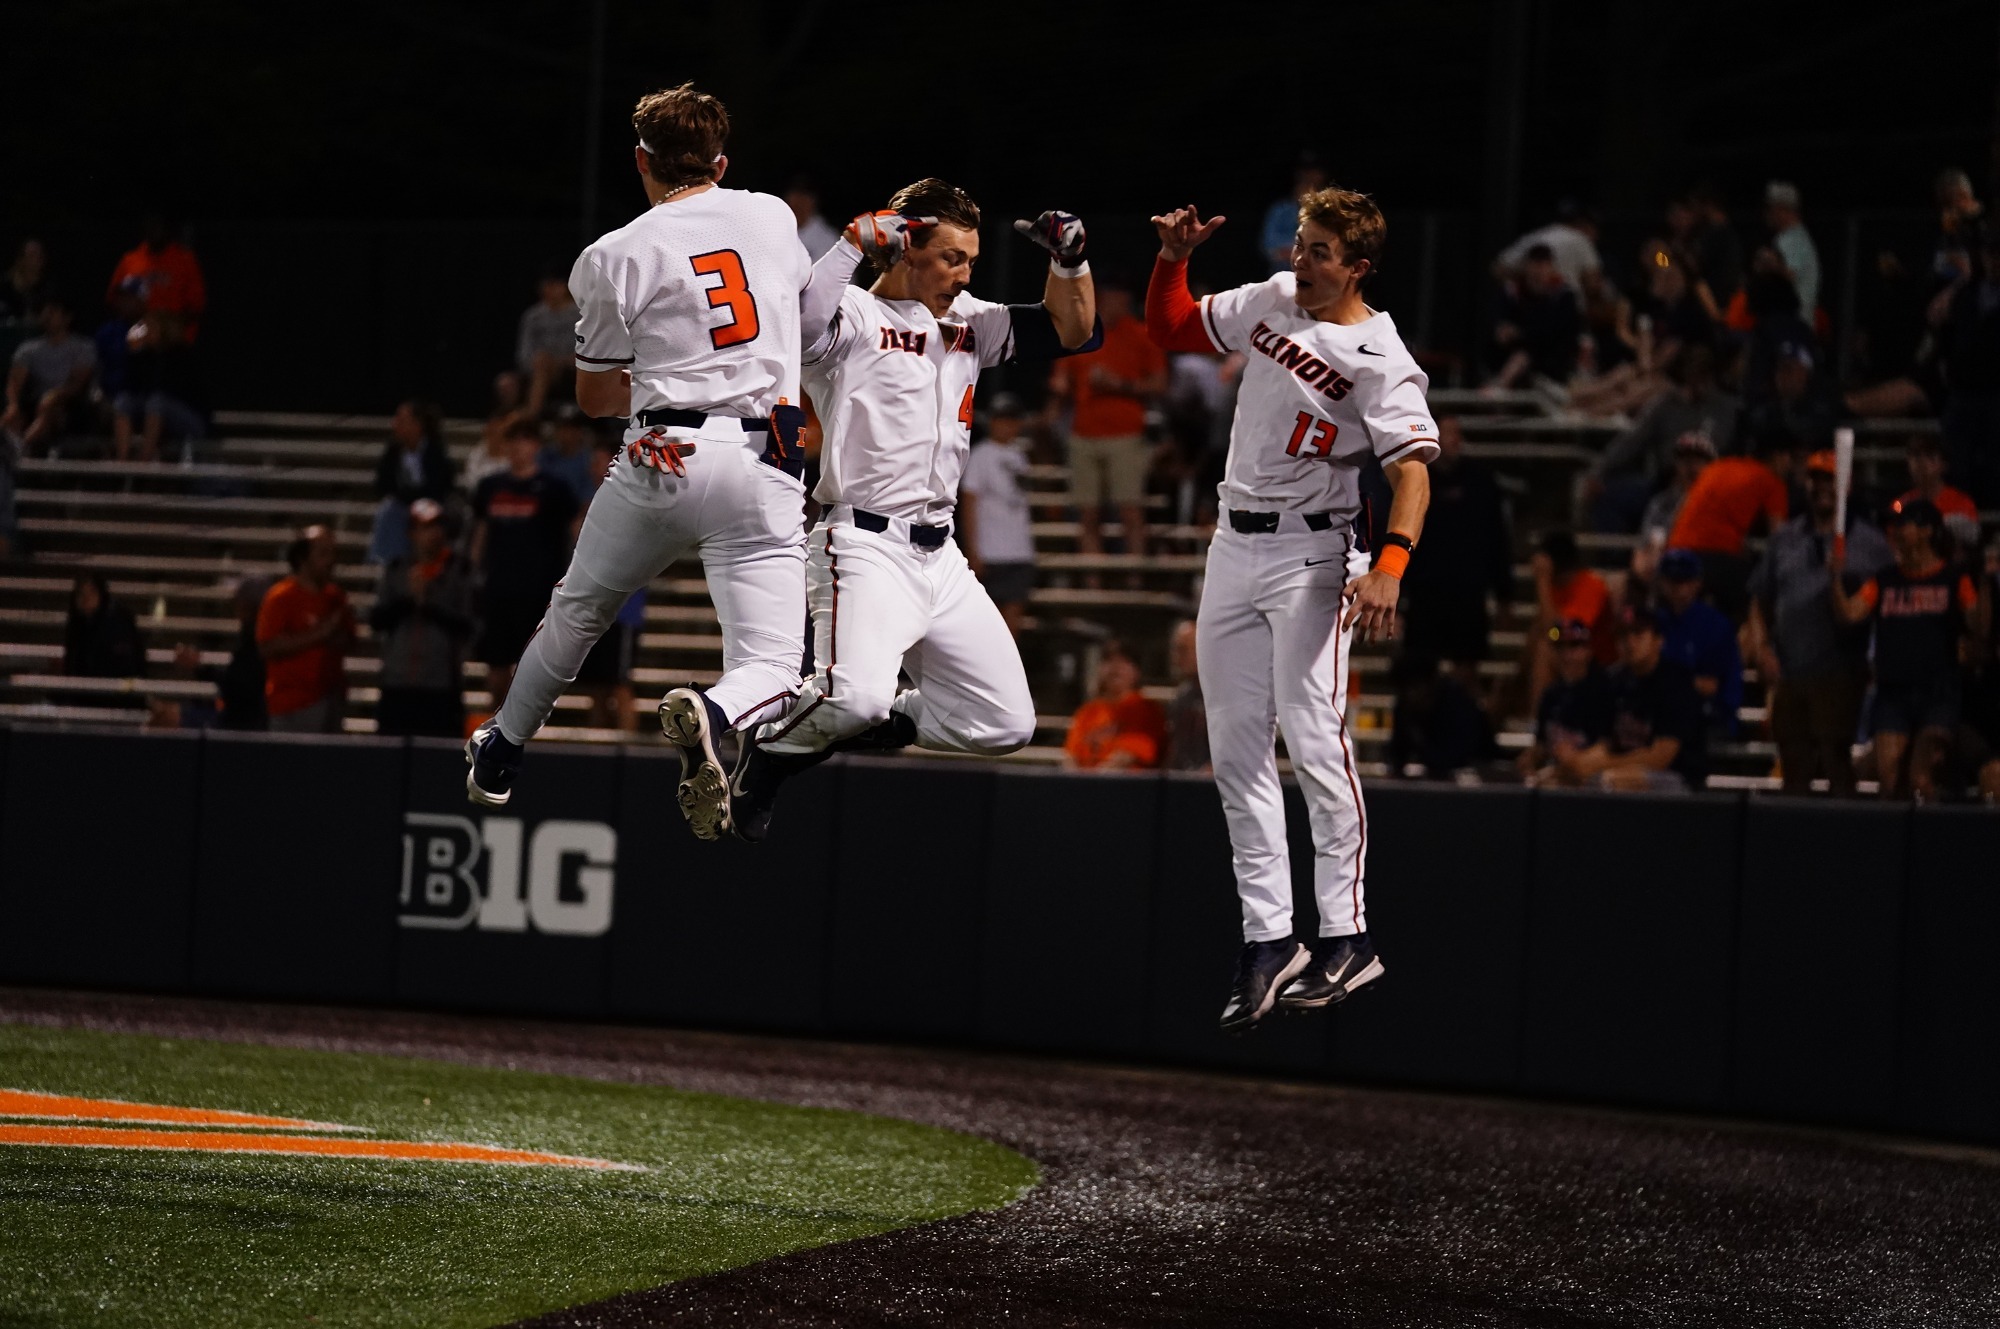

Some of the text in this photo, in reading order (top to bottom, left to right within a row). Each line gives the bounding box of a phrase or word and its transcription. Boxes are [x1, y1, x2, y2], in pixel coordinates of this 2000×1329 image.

[689, 248, 760, 351] 3
[1250, 321, 1354, 401] ILLINOIS
[958, 384, 976, 431] 4
[1285, 410, 1339, 459] 13
